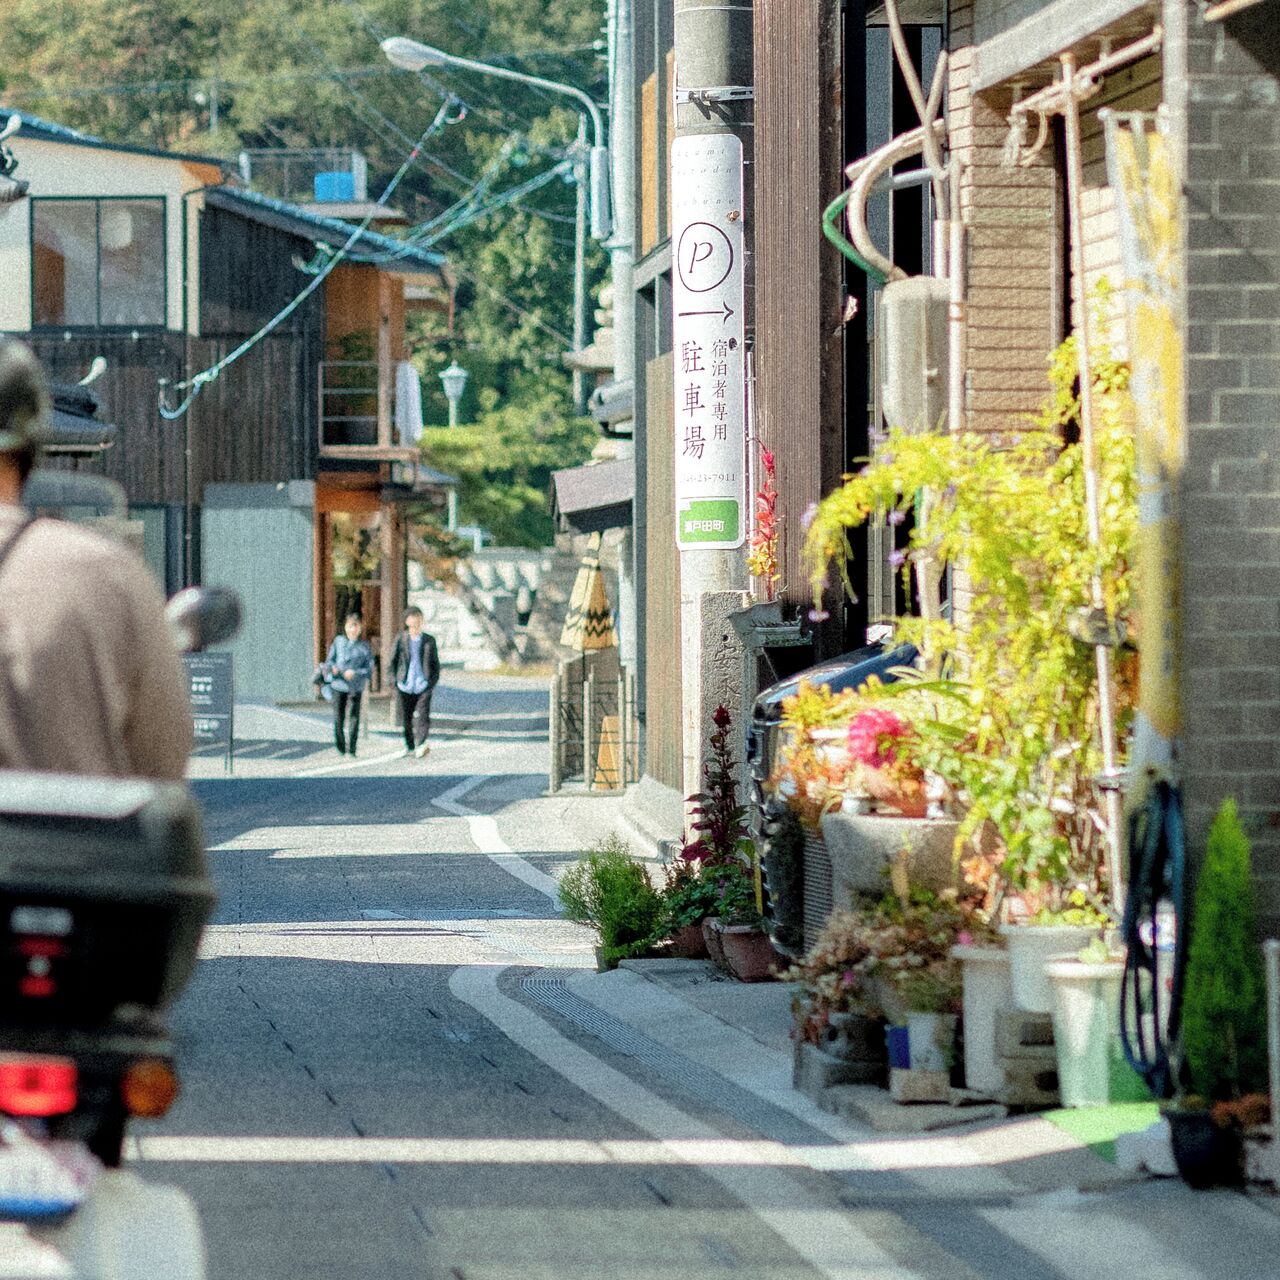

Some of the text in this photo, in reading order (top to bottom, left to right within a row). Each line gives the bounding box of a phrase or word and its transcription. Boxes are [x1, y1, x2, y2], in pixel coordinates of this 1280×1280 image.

[688, 241, 714, 274] P
[681, 340, 706, 460] 駐車場
[712, 339, 727, 441] 宿泊者専用
